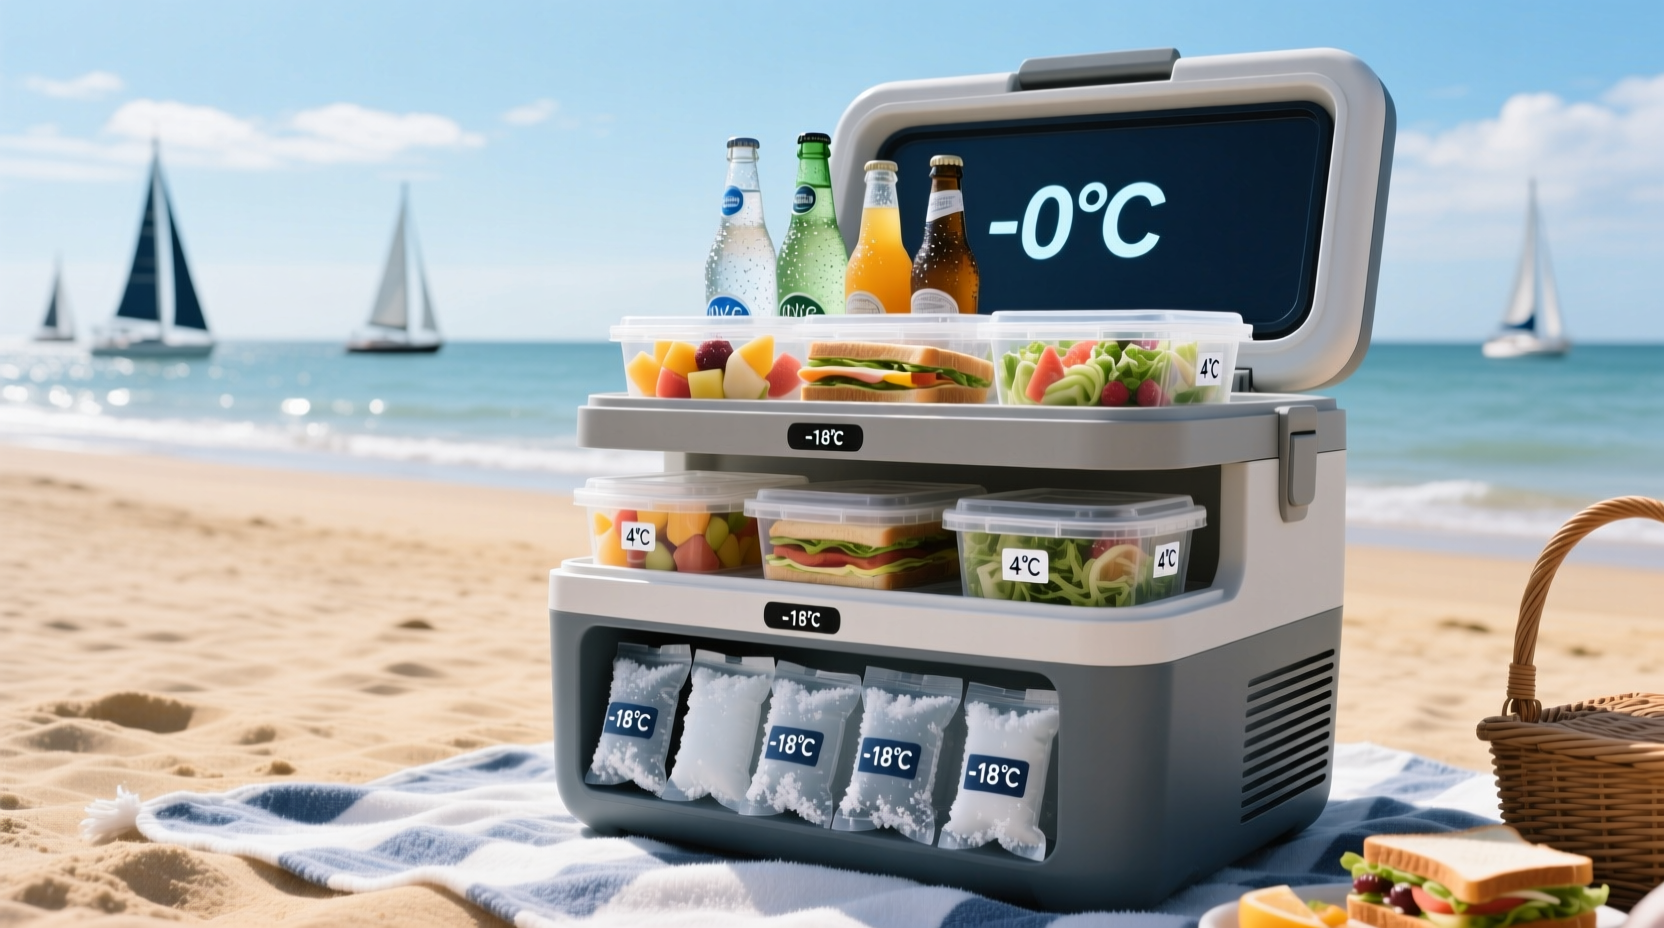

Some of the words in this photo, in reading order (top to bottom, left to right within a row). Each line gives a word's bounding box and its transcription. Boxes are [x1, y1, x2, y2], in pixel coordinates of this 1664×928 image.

[988, 181, 1166, 260] -0°C
[1009, 555, 1041, 577] 4°C
[609, 709, 651, 732] -18°C
[769, 734, 816, 757] -18°C
[863, 746, 913, 770] -18°C
[968, 763, 1021, 788] -18°C
